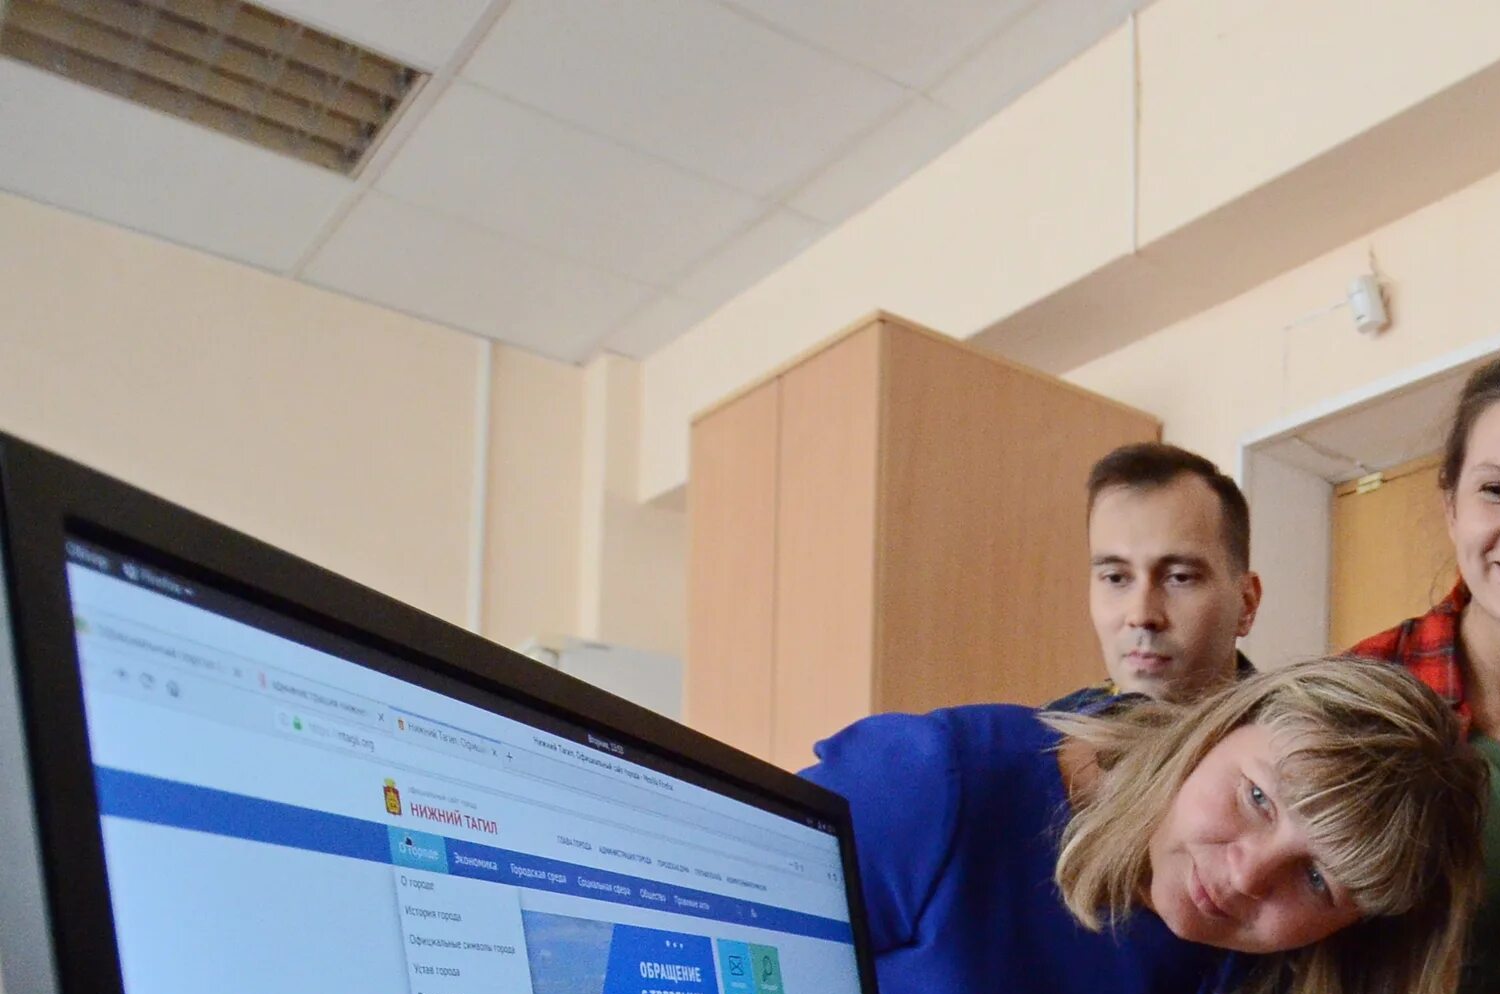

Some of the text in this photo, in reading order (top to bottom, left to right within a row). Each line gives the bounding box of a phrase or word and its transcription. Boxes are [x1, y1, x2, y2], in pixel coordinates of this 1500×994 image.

[410, 802, 498, 835] НИЖНИЙ ТАГИЛ
[454, 852, 498, 871] Экономика
[401, 876, 434, 891] О городе
[510, 864, 567, 884] Городская среда
[577, 876, 632, 897] Социальная сфера
[405, 906, 461, 922] История города
[409, 934, 515, 955] Официальные символы города
[413, 963, 460, 977] Устав города
[639, 961, 702, 984] ОБРАЩЕНИЕ
